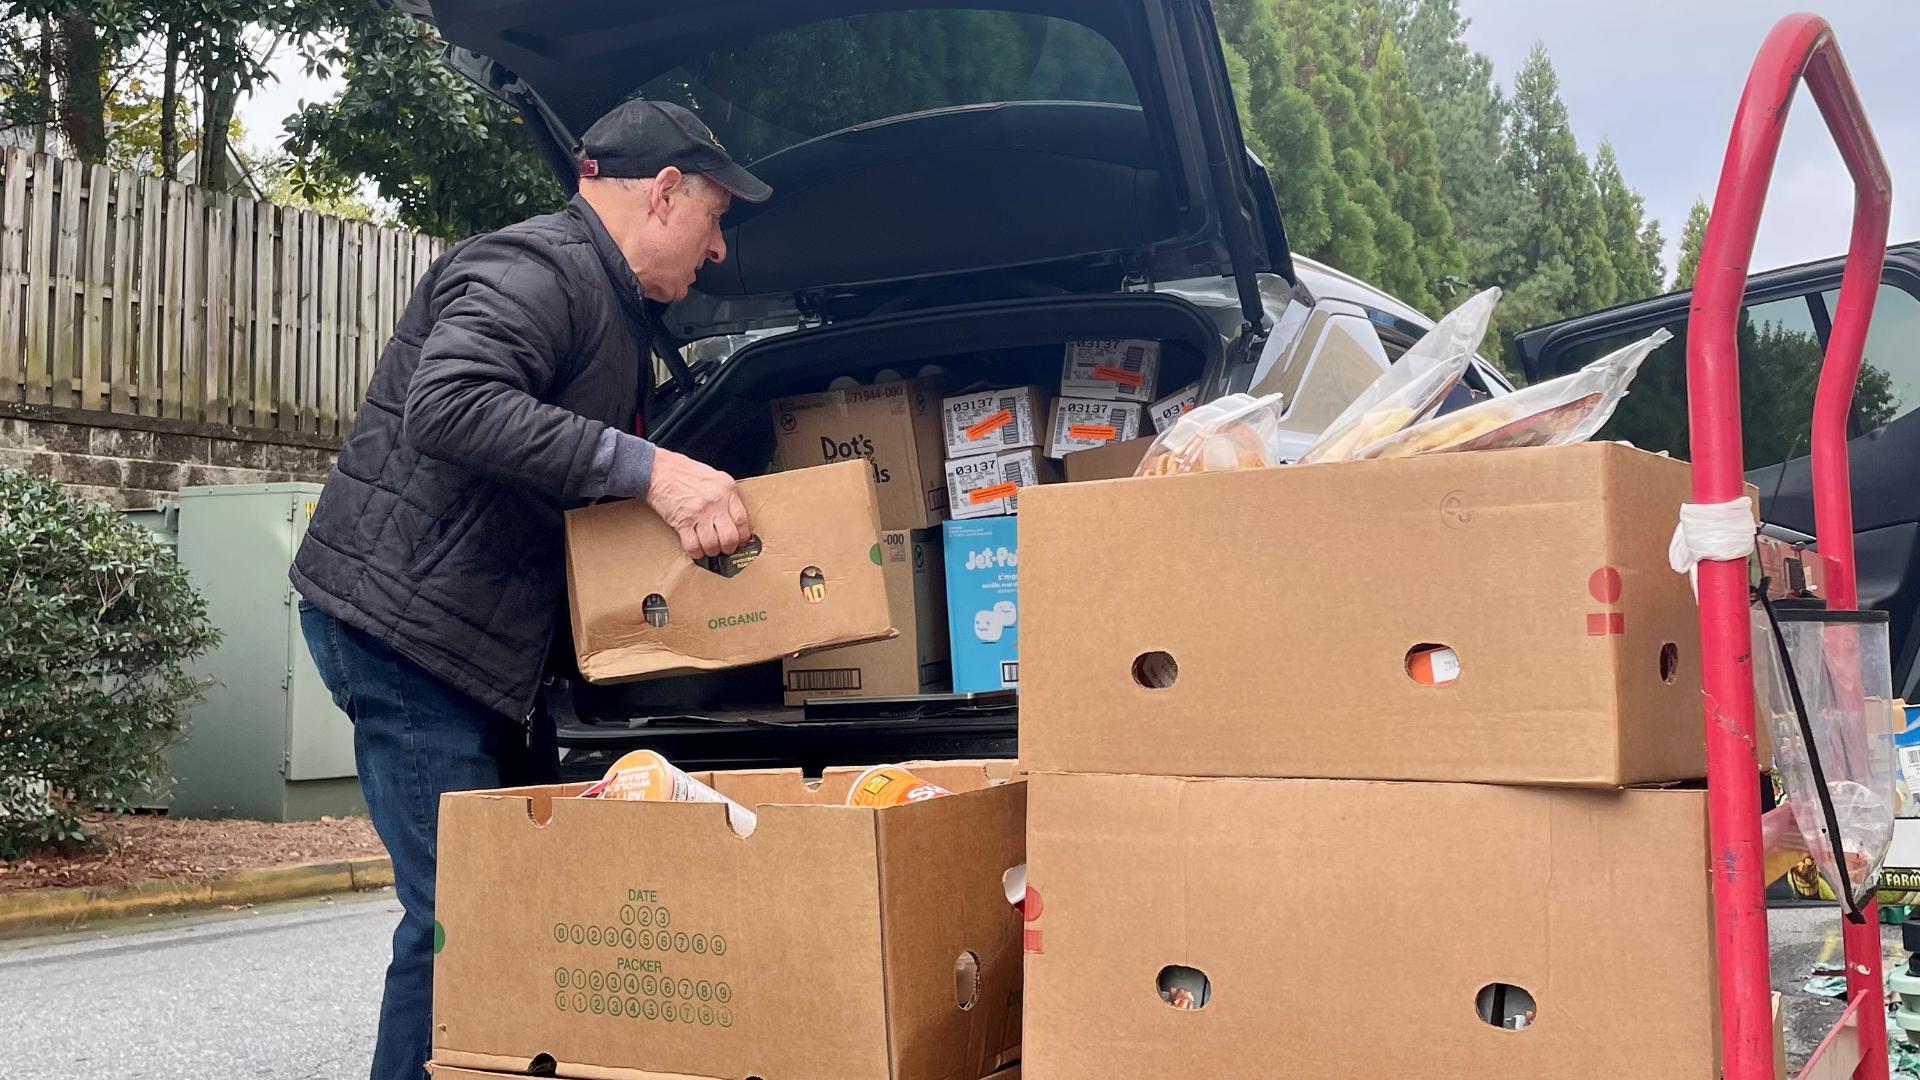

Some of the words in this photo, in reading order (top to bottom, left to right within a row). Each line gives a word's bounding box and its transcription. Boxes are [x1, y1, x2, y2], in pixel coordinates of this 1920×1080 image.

[953, 398, 993, 412] 03137
[1067, 402, 1108, 414] 03137
[820, 434, 875, 461] Dot's
[955, 459, 996, 476] 03137
[965, 546, 1017, 571] Jet-Pu
[707, 610, 769, 631] ORGANIC
[628, 888, 657, 903] DATE
[617, 957, 662, 973] PACKER
